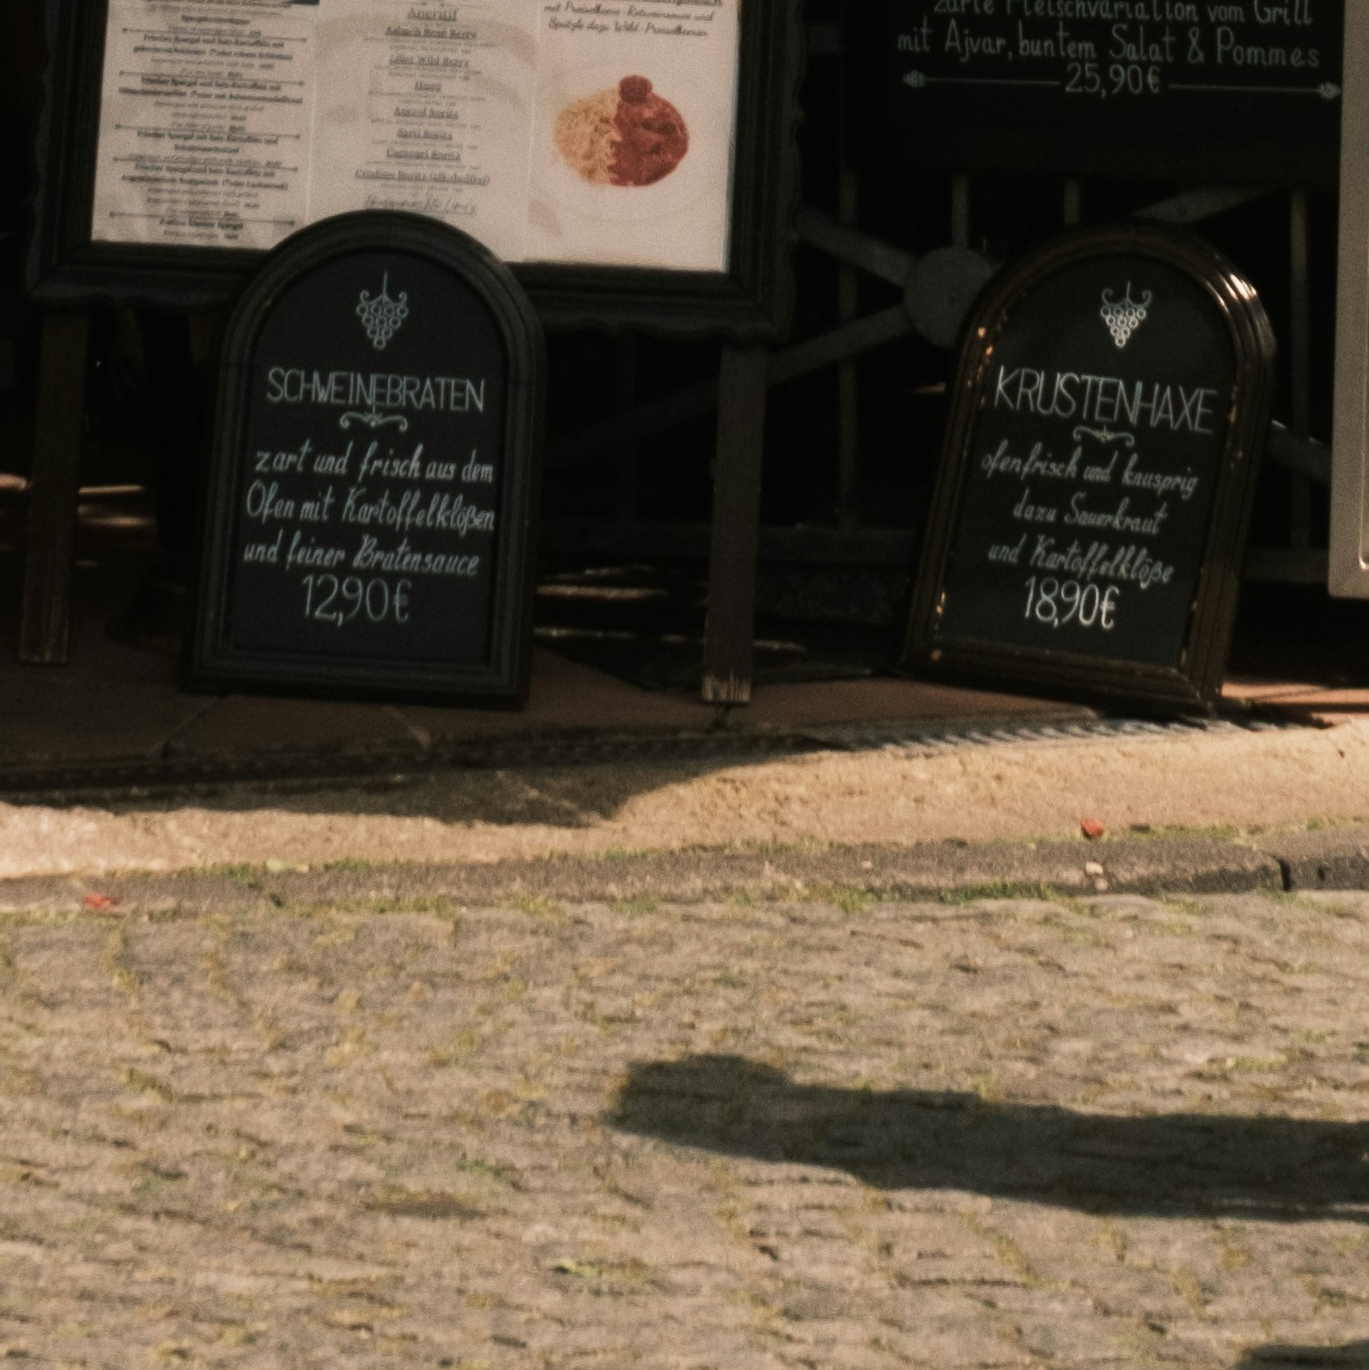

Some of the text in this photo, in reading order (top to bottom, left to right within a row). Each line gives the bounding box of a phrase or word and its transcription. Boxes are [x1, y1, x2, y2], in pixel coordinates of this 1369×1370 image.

[1207, 2, 1244, 24] vom
[898, 17, 933, 55] mit
[1018, 20, 1096, 60] buntem
[1110, 24, 1178, 63] Salat
[1187, 28, 1204, 64] &
[1216, 28, 1320, 69] Pommes
[1065, 63, 1161, 98] 25,90€
[267, 368, 485, 412] SCHWEINEBRATEN
[993, 364, 1219, 435] KRUSTENHAXE
[255, 438, 494, 484] zart und frisch aus dem
[981, 439, 1200, 501] ofenfrisch und knusprig
[246, 479, 496, 538] Ofen mit Kartoffelklößen
[1013, 489, 1168, 536] dazu Sauerkraut
[243, 529, 480, 576] und feiner Bratensauce
[988, 533, 1174, 590] und Kartoffelklöße
[302, 573, 412, 627] 12,90€
[1024, 575, 1120, 630] 18,90€
